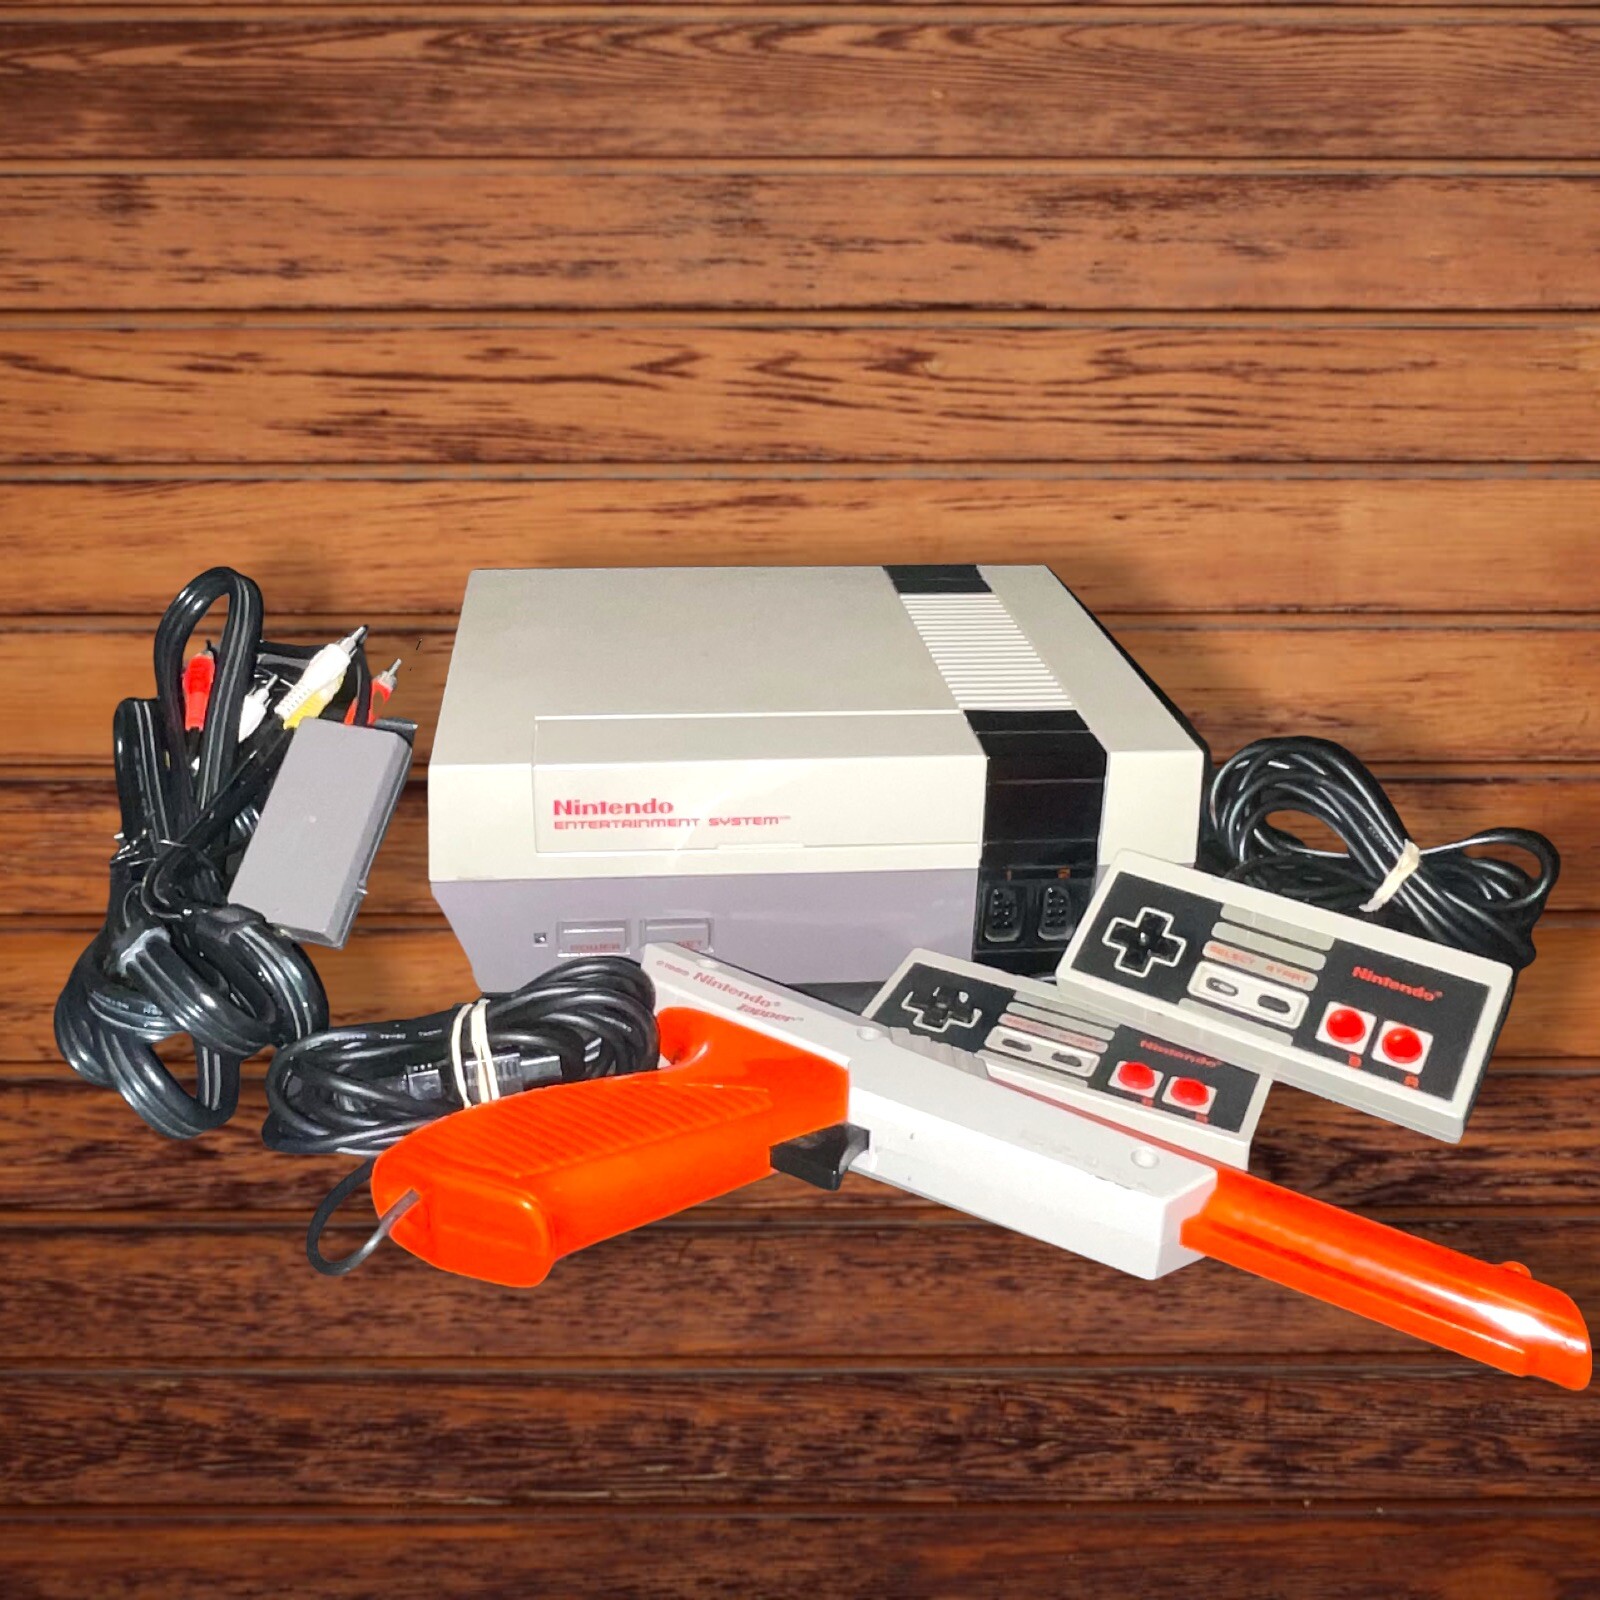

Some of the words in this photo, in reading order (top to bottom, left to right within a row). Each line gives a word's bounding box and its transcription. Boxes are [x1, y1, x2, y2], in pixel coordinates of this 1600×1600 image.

[553, 797, 674, 816] Nintendo
[554, 818, 700, 830] ENTERTAINMENT
[693, 971, 771, 1008] Nintendo
[1352, 966, 1435, 1001] Nintendo
[1140, 1040, 1216, 1068] Nintendo
